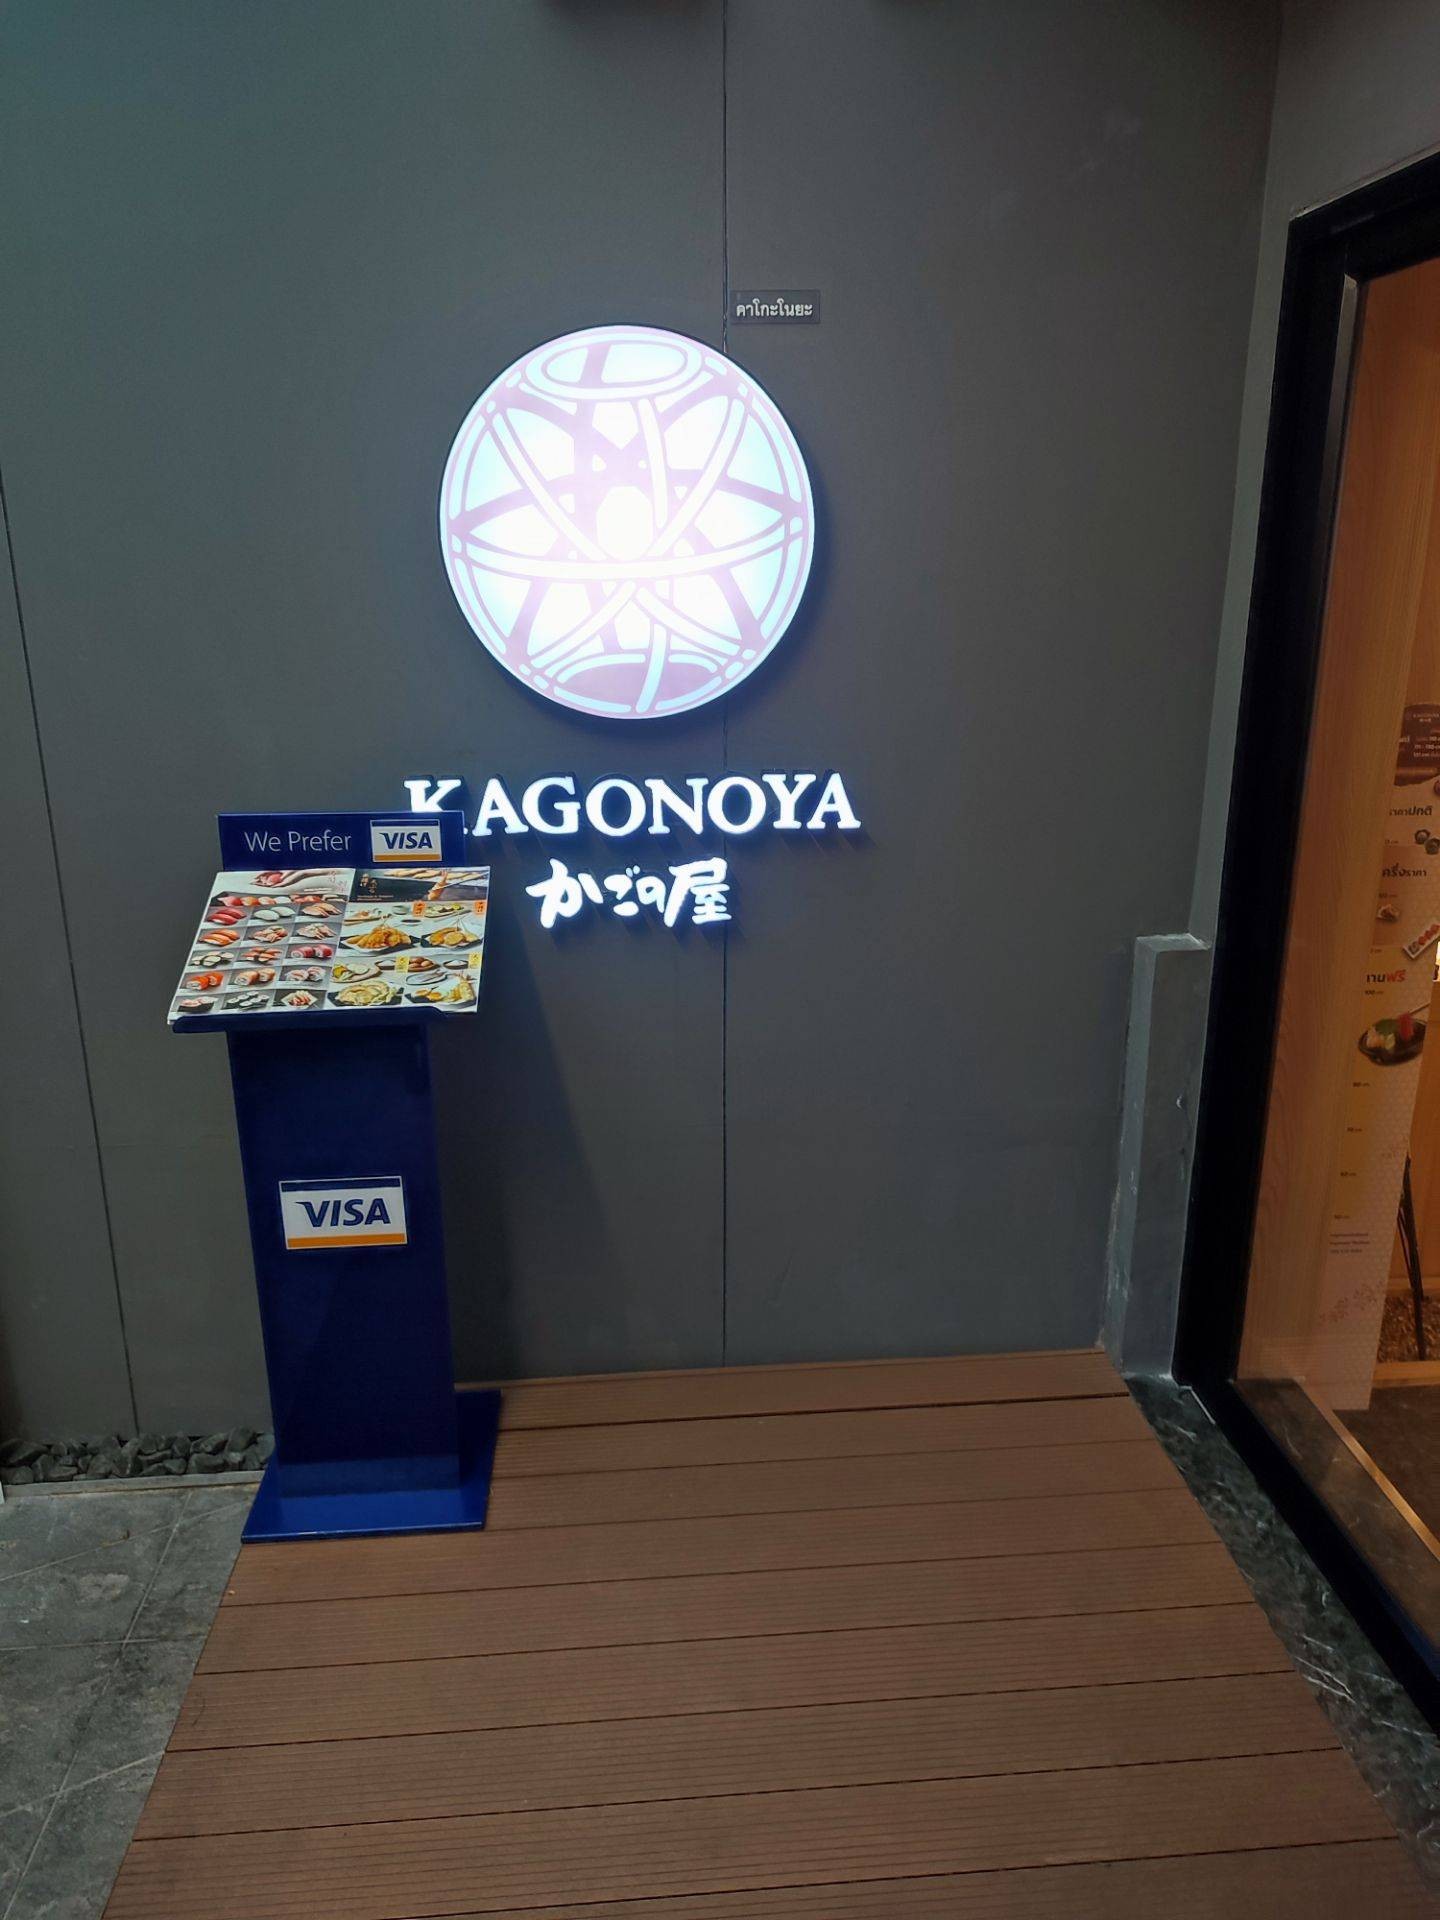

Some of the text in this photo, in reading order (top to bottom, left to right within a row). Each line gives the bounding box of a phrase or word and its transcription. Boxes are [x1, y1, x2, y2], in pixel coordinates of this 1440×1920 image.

[736, 298, 813, 317] คาโกะโนยะ
[403, 773, 862, 837] KAGONOYA
[244, 829, 433, 852] We Prefer VISA
[525, 857, 732, 929] かごの屋
[295, 1198, 391, 1228] VISA
